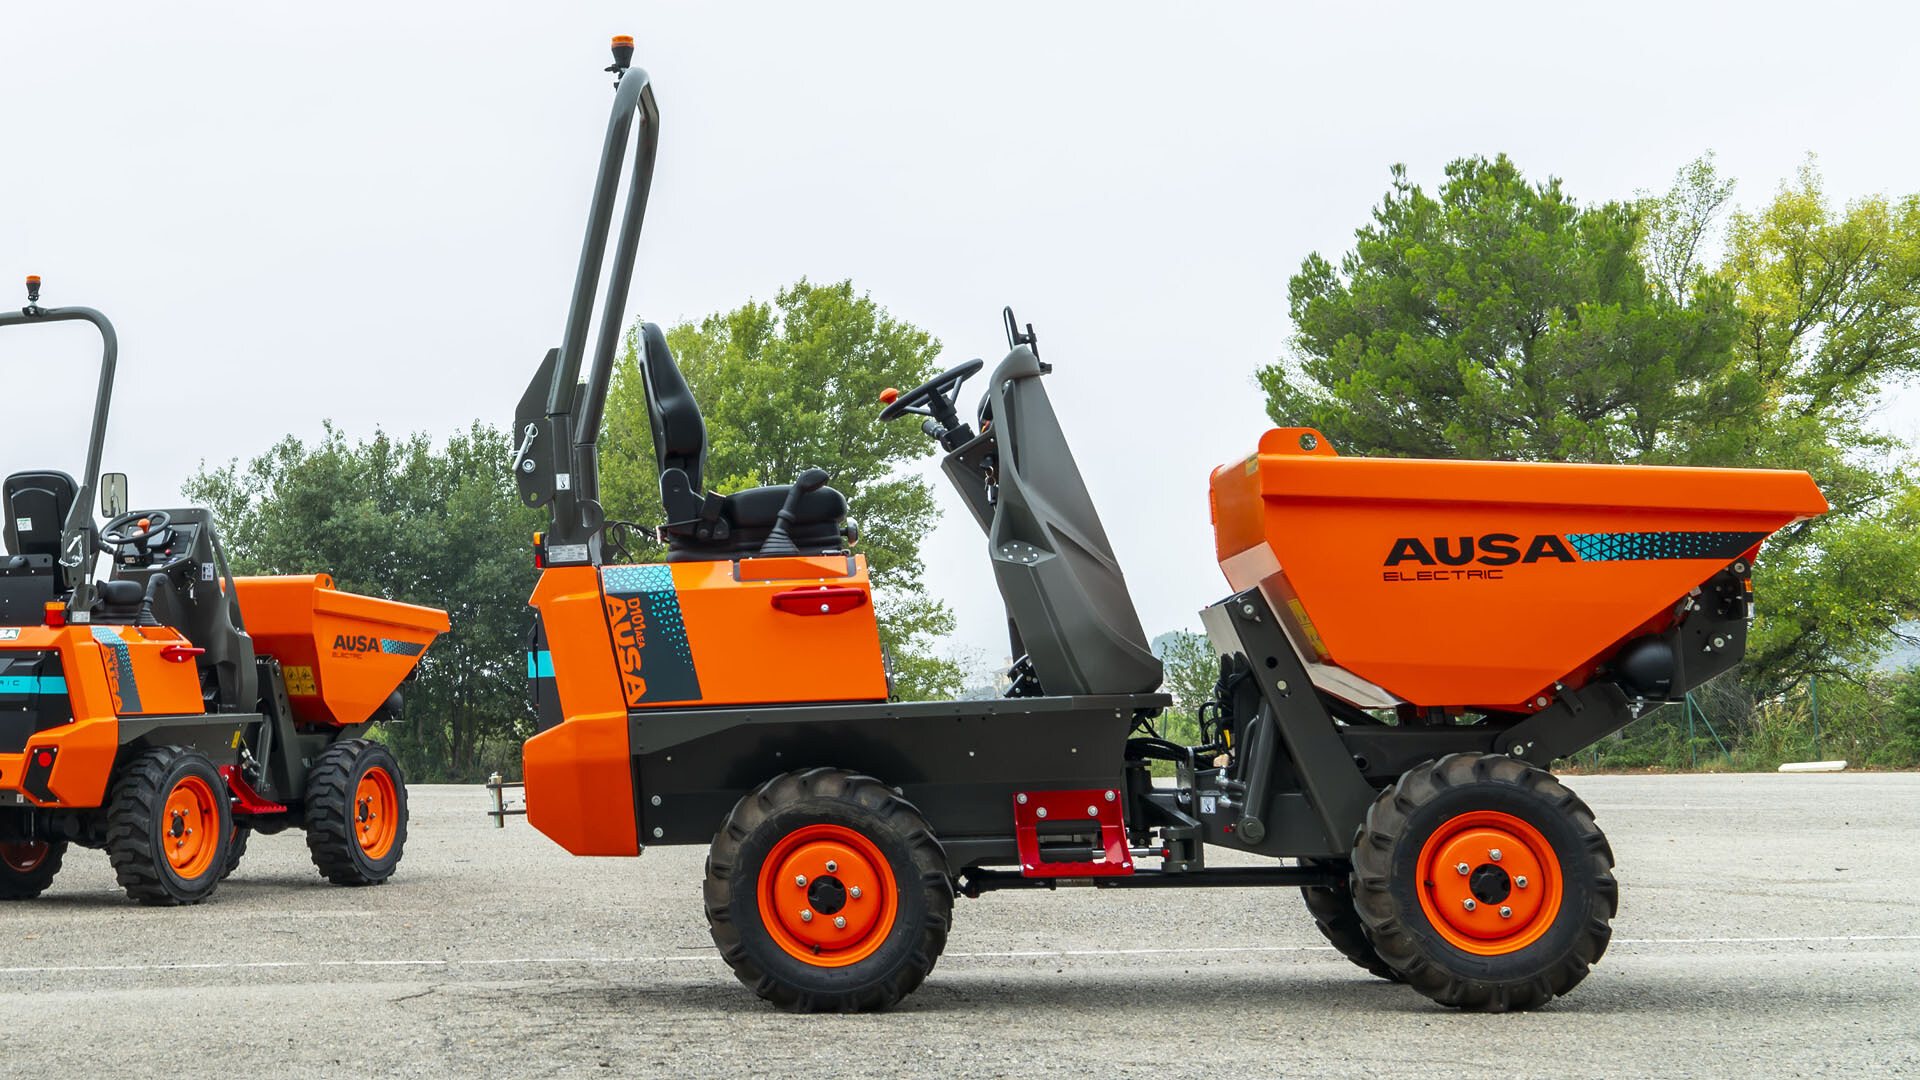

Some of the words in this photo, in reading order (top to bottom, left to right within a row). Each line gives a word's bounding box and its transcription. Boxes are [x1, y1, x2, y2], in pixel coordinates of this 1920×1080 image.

[1383, 533, 1576, 566] AUSA
[1383, 570, 1504, 581] ELECTRIC
[333, 635, 380, 652] AUSA
[605, 594, 647, 704] AUSA
[101, 643, 123, 713] AUSA
